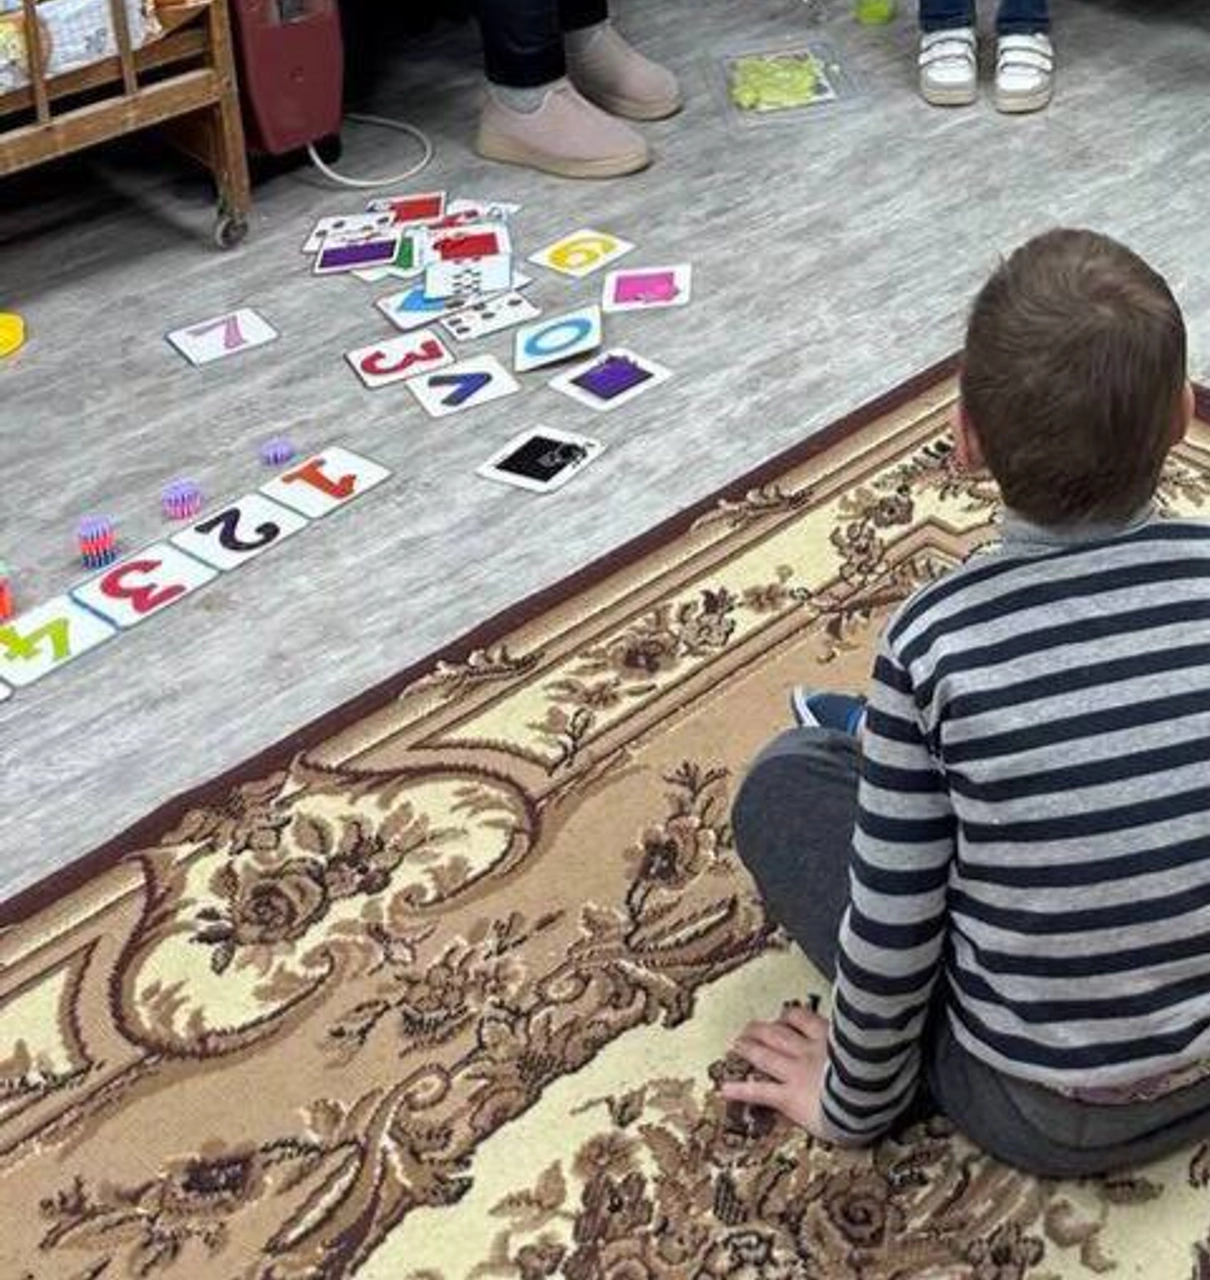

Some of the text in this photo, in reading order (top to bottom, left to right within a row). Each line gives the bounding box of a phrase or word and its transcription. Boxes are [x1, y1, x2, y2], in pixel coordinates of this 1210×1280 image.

[185, 314, 243, 349] 7
[361, 339, 444, 374] 3
[0, 458, 357, 662] 1 2 3 4
